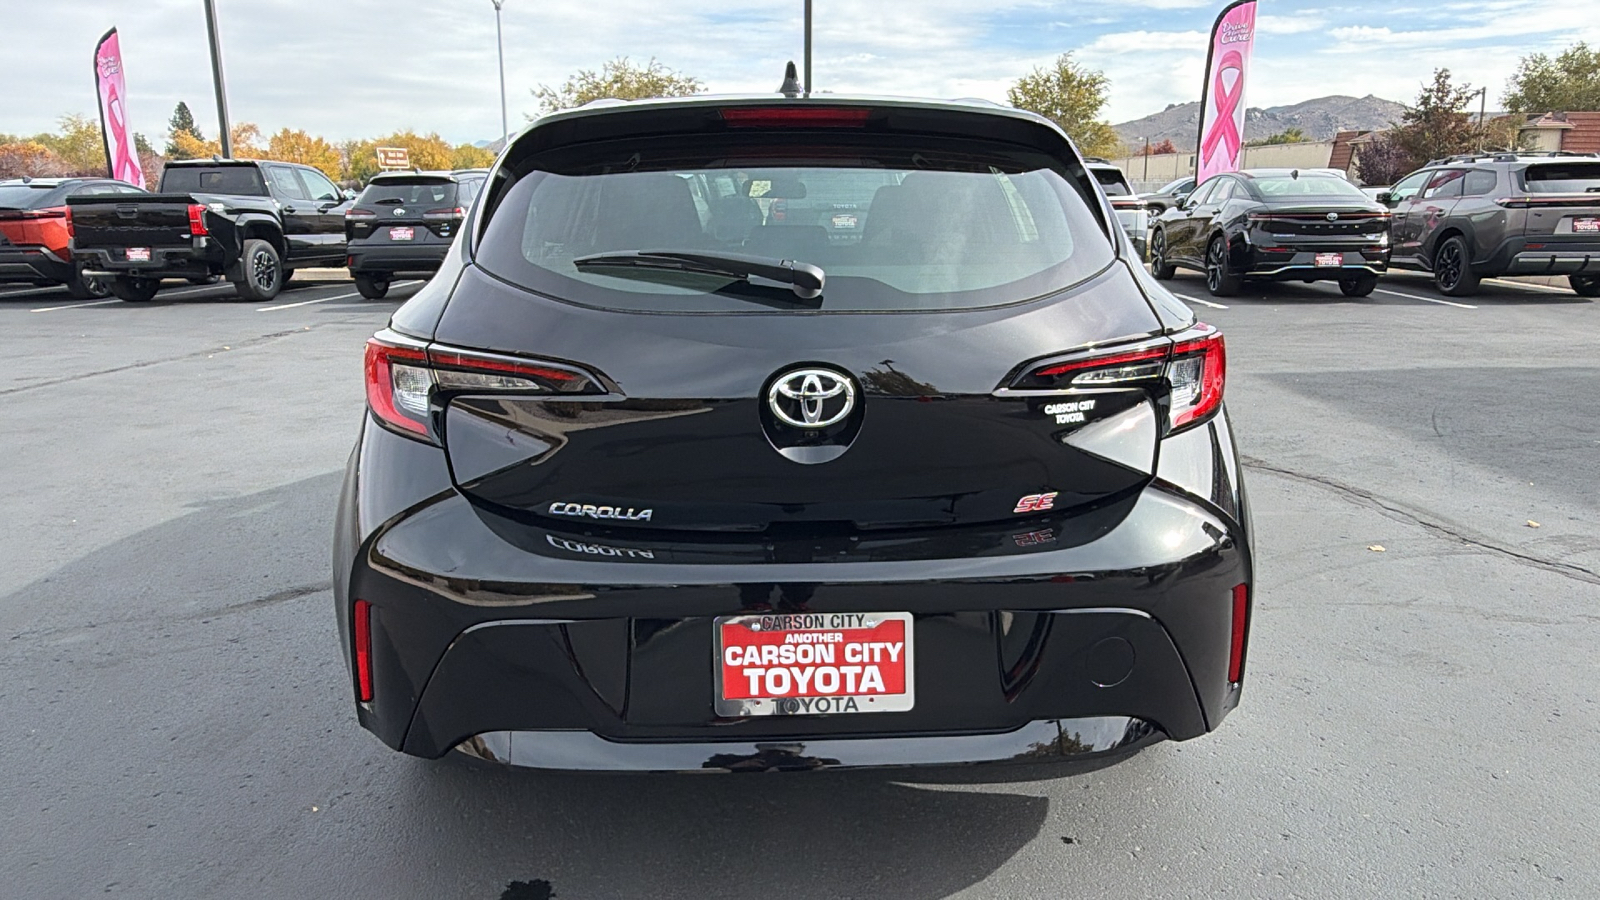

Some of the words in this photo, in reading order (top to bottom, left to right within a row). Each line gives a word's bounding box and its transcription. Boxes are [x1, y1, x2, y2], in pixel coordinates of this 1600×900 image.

[1044, 402, 1078, 415] CARSON
[1078, 400, 1096, 411] CITY
[1055, 412, 1085, 424] TOYOTA
[1013, 491, 1059, 513] SE
[548, 502, 653, 521] COROLLA
[762, 614, 825, 631] CARSON
[830, 614, 865, 628] CITY
[785, 632, 843, 643] ANOTHER
[725, 644, 835, 666] CARSON
[844, 642, 903, 663] CITY
[743, 665, 885, 695] TOYOTA
[771, 697, 859, 713] TOYOTA
